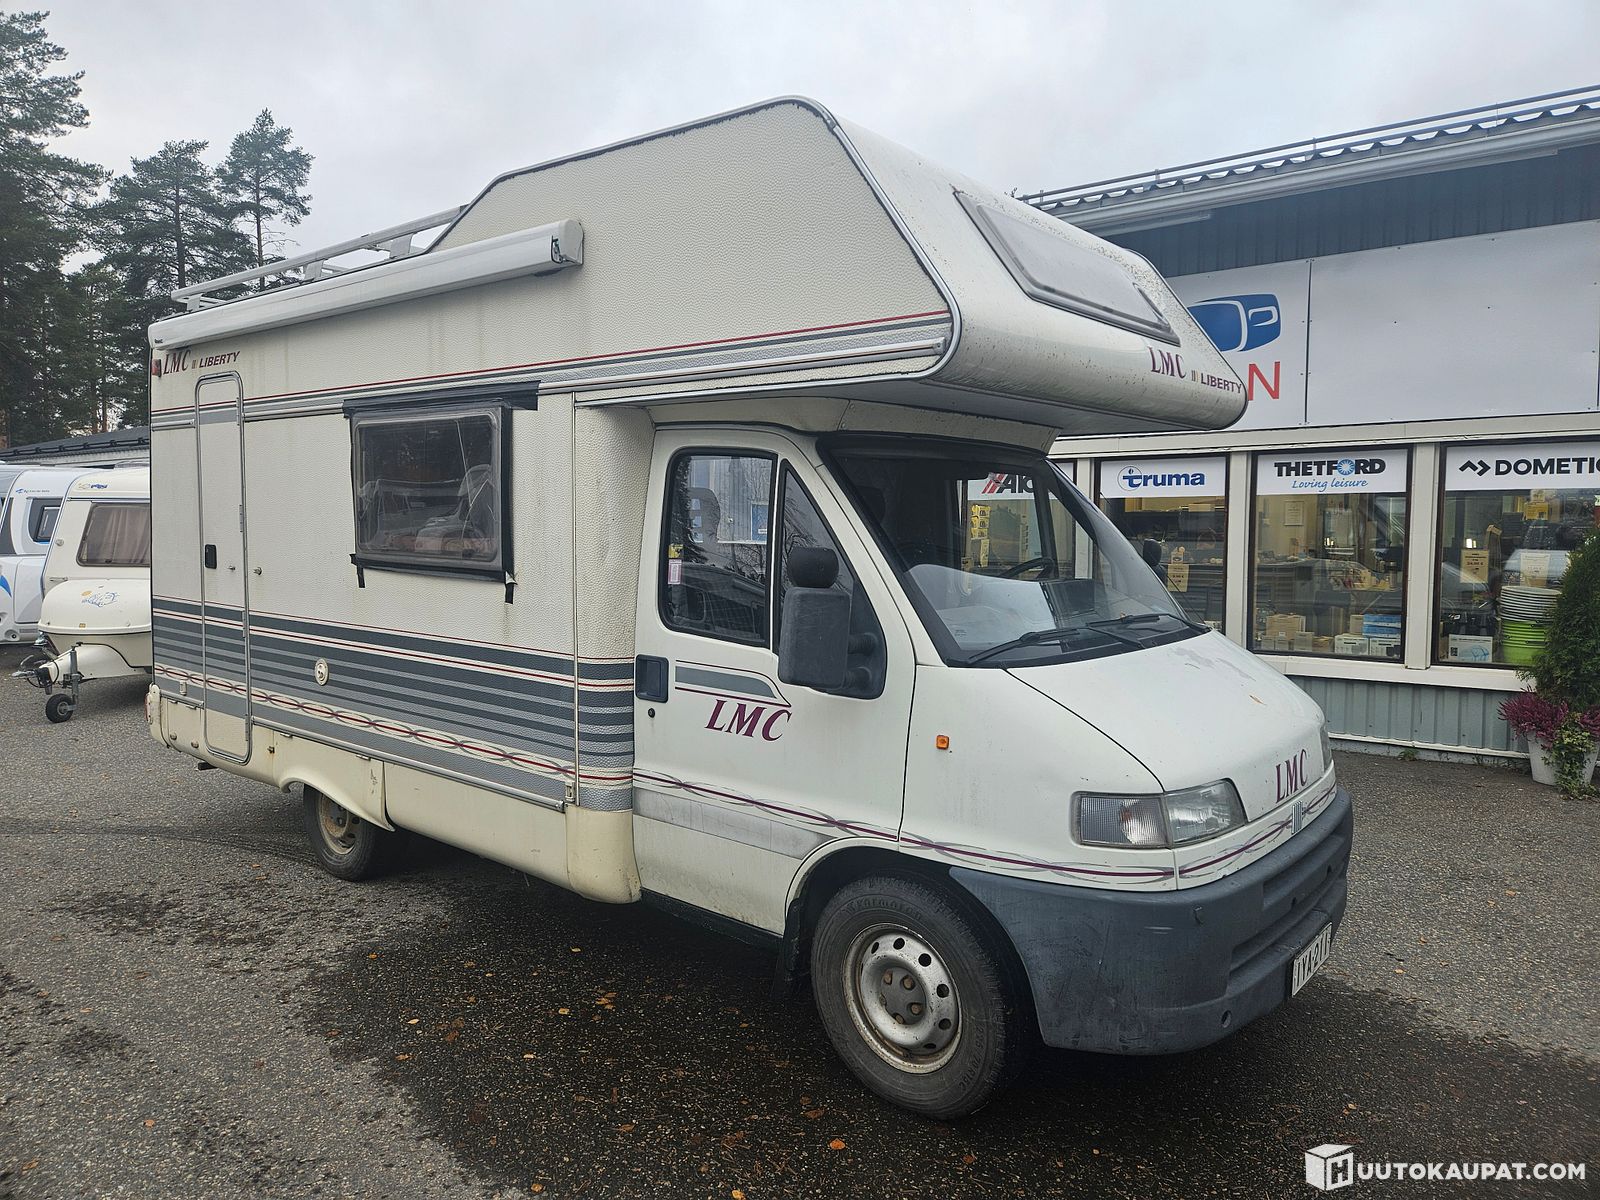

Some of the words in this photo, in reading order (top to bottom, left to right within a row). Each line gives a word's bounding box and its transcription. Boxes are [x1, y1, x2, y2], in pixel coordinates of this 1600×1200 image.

[163, 349, 191, 375] LMC
[199, 351, 241, 369] LIBERTY
[1148, 345, 1187, 379] LMC
[1200, 372, 1242, 394] LIBERTY
[1122, 469, 1205, 488] truma
[1274, 458, 1386, 478] THETFORD
[1291, 479, 1328, 493] Loving
[1331, 477, 1369, 489] leisure
[704, 699, 792, 742] LMC
[1275, 749, 1308, 804] LMC
